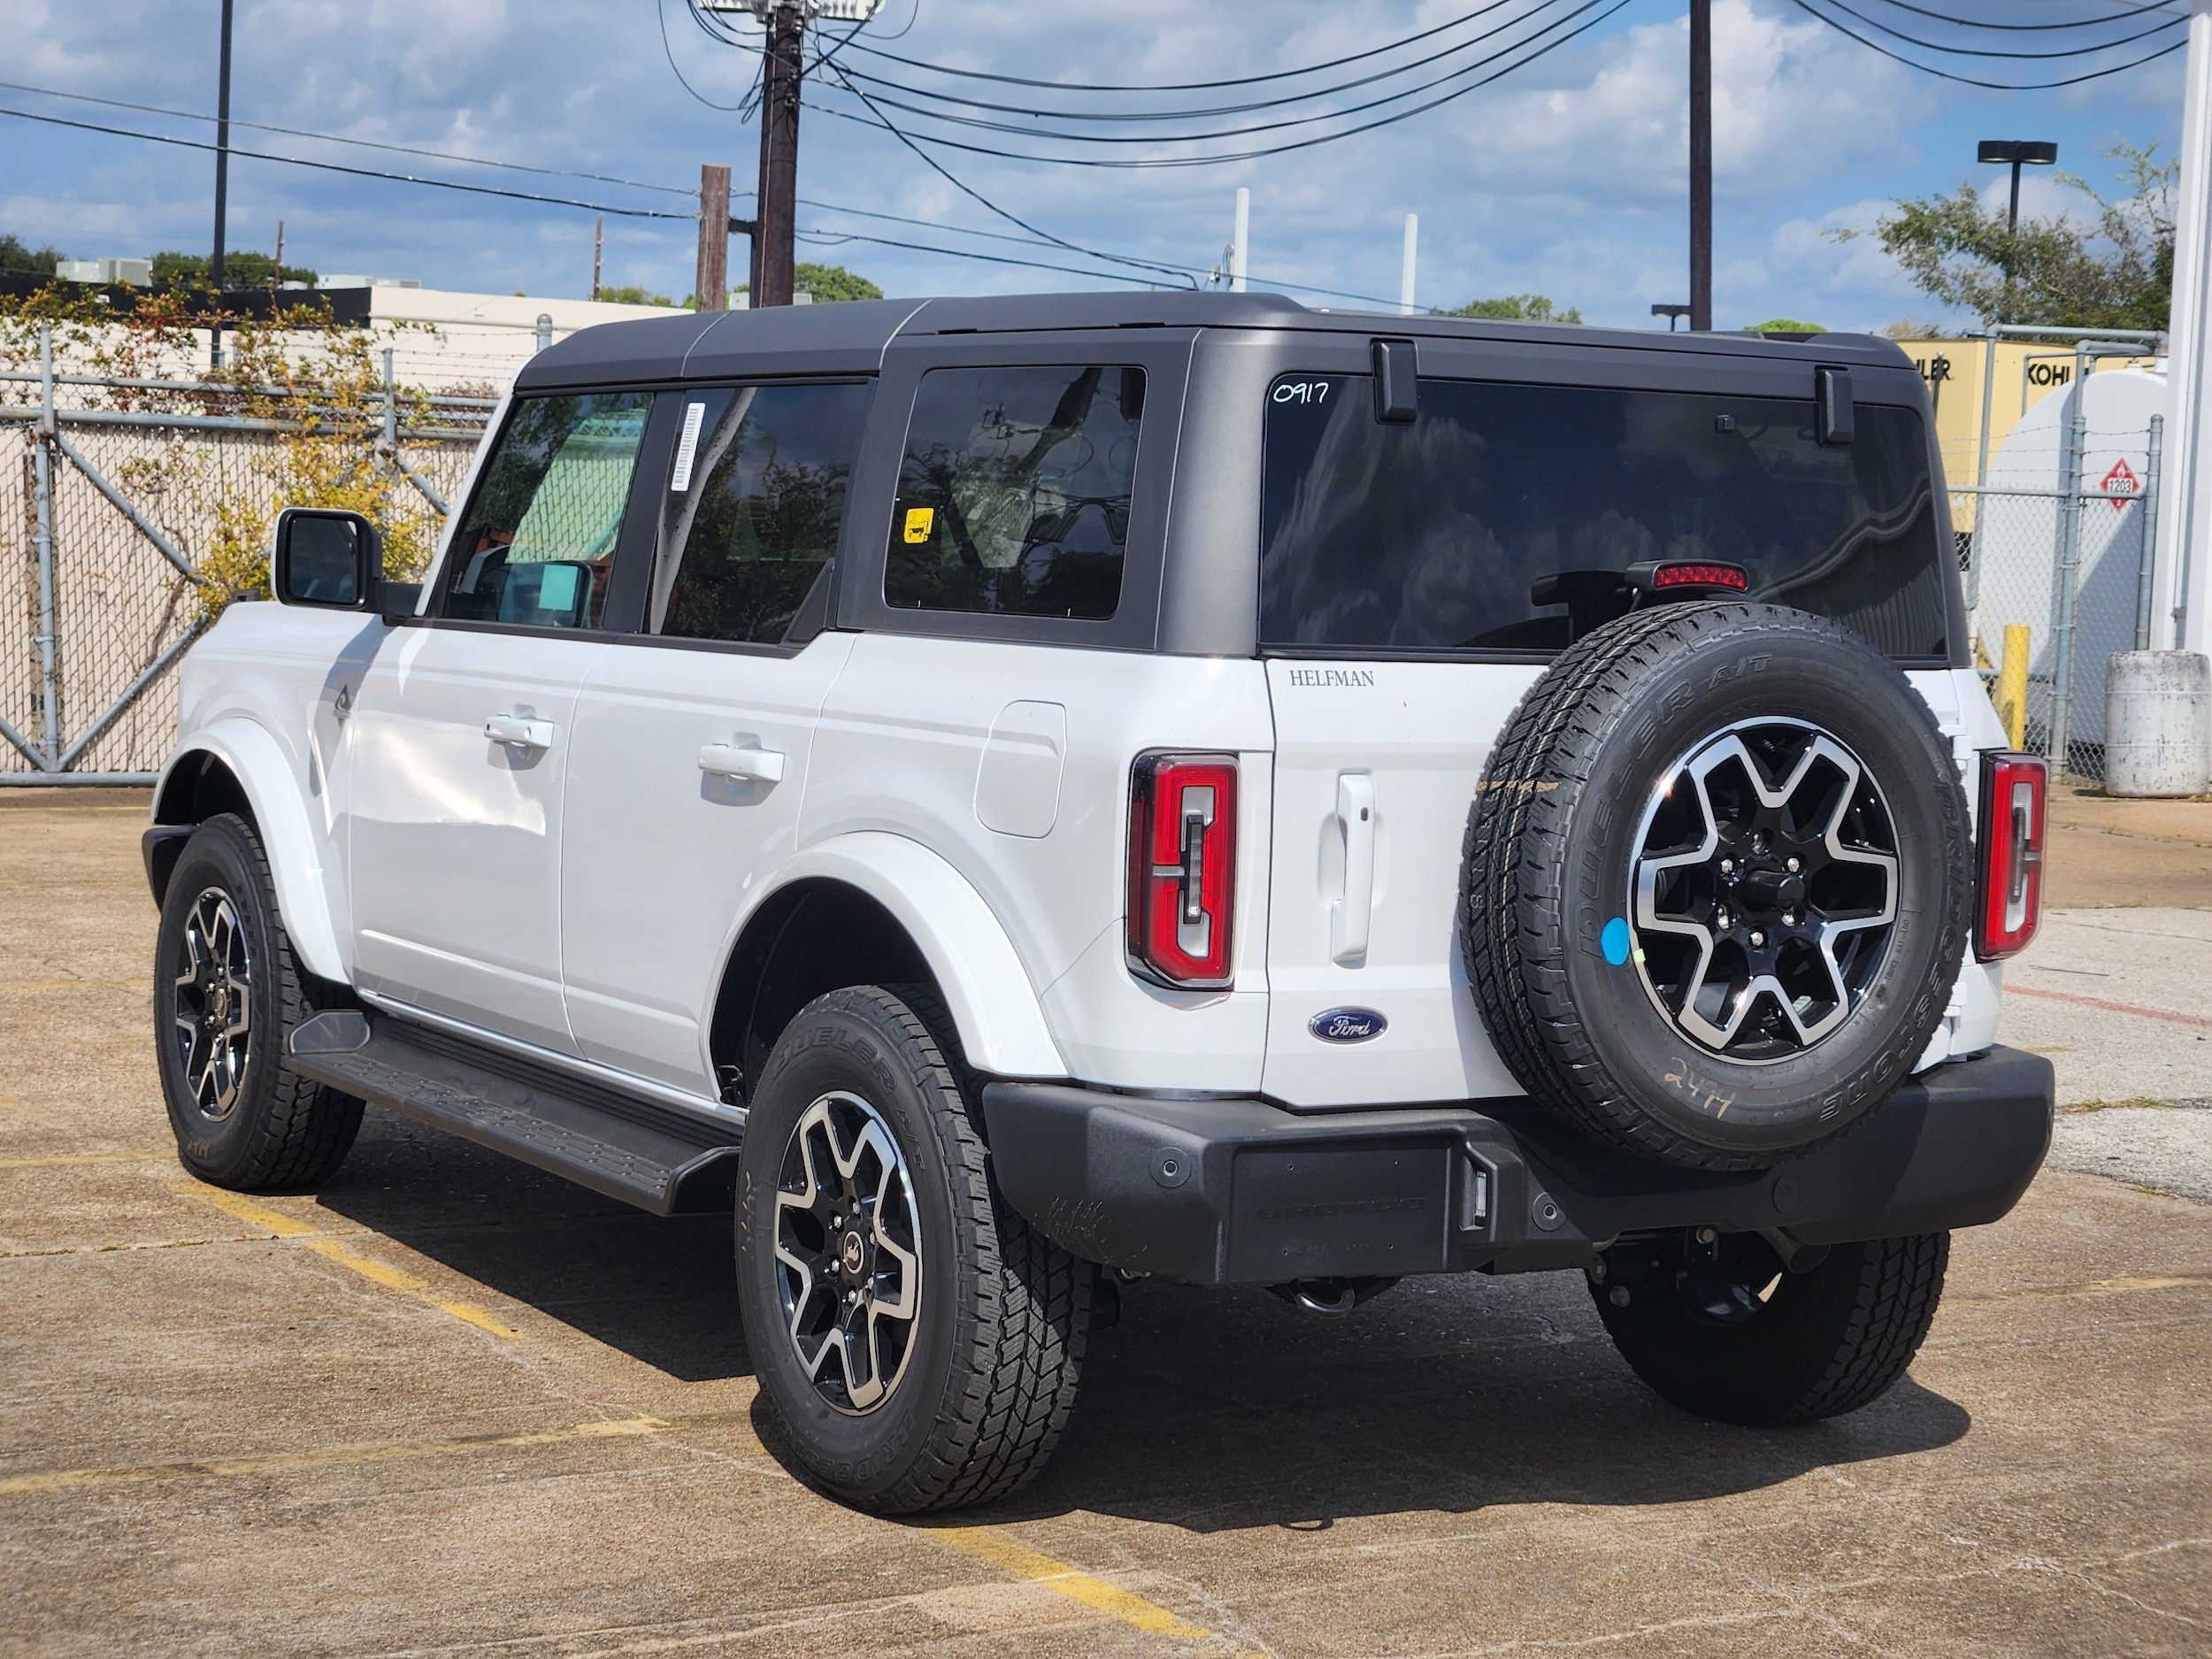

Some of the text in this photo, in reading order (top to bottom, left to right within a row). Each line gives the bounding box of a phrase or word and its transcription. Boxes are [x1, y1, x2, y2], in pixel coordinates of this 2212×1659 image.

[1273, 382, 1330, 404] 0917
[2109, 480, 2131, 493] 1203
[1288, 670, 1375, 687] HELFMAN
[1819, 782, 1962, 1122] BRIDGESTONE
[1328, 1016, 1372, 1036] Ford
